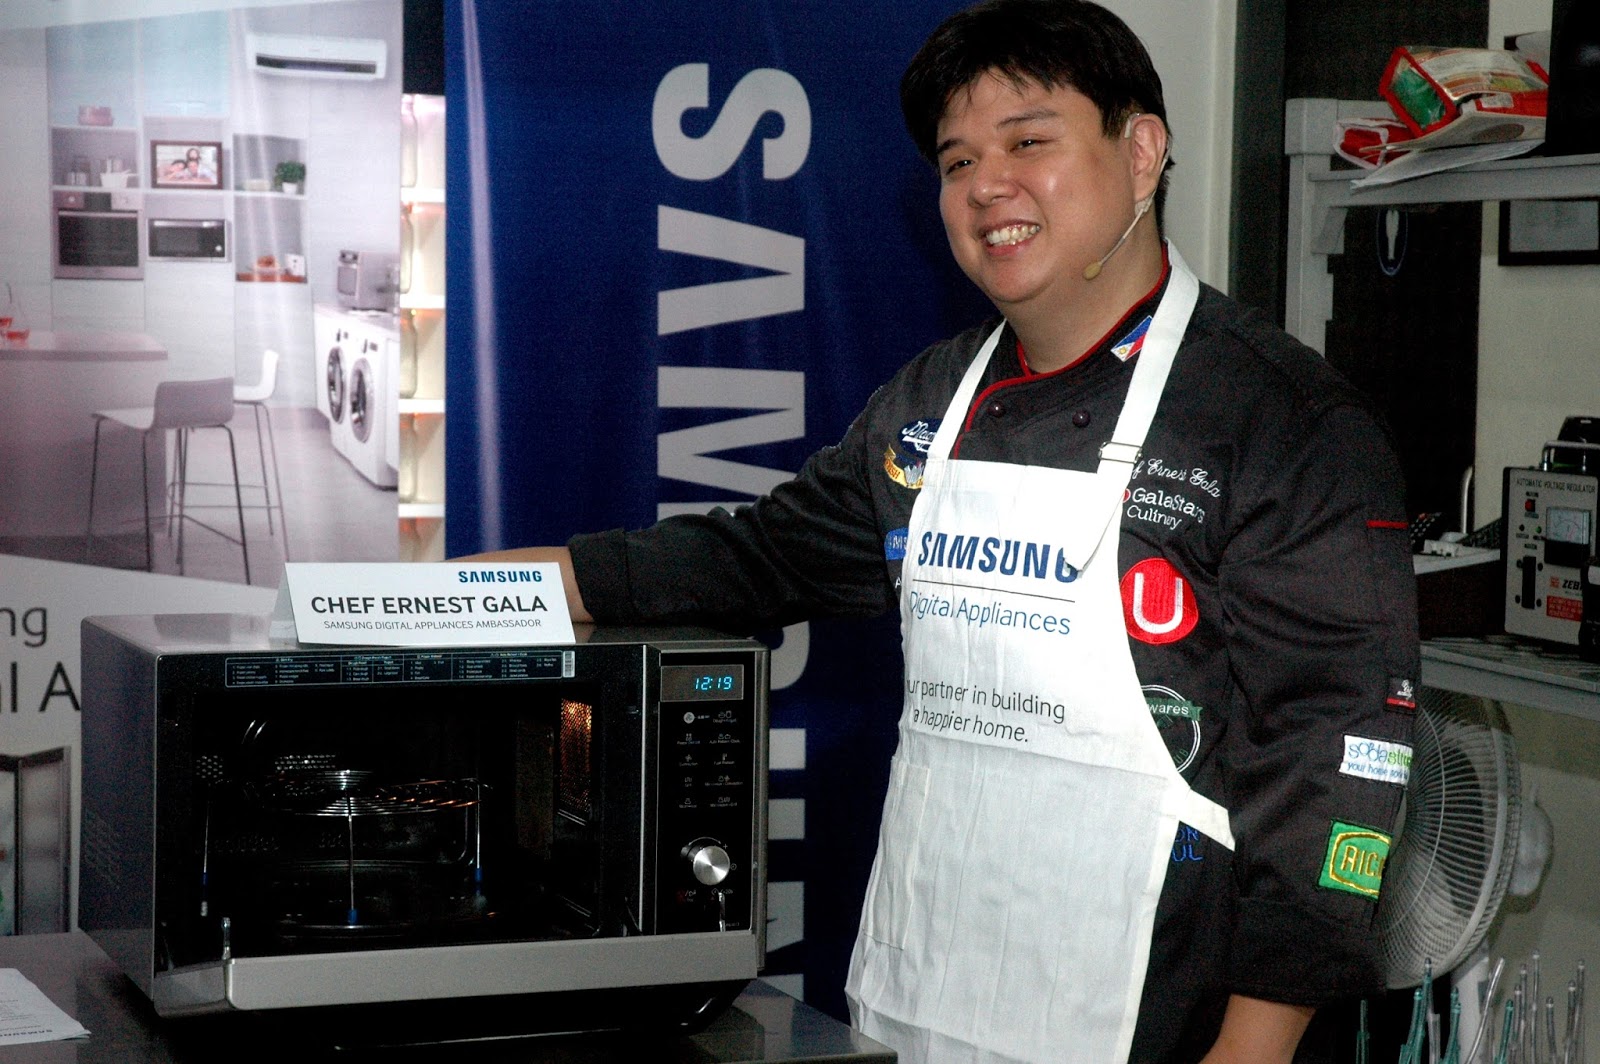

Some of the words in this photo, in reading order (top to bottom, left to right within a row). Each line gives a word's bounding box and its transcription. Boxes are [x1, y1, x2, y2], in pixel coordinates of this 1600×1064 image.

[1189, 467, 1220, 498] Gala
[458, 570, 543, 583] SAMSUNG
[1562, 579, 1582, 590] ZEB
[311, 596, 375, 614] CHEF
[382, 596, 476, 614] ERNEST
[482, 595, 548, 613] GALA
[909, 590, 954, 620] Digital
[956, 597, 1071, 635] Appliances
[324, 620, 373, 630] SAMSUNG
[375, 620, 413, 630] DIGITAL
[414, 620, 474, 630] APPLIANCES
[476, 619, 542, 629] AMBASSADOR
[694, 676, 733, 690] 12:19
[921, 680, 969, 702] partner
[972, 685, 987, 706] in
[992, 688, 1065, 725] building
[913, 708, 920, 722] a
[920, 706, 971, 732] happier
[972, 715, 1029, 743] home.
